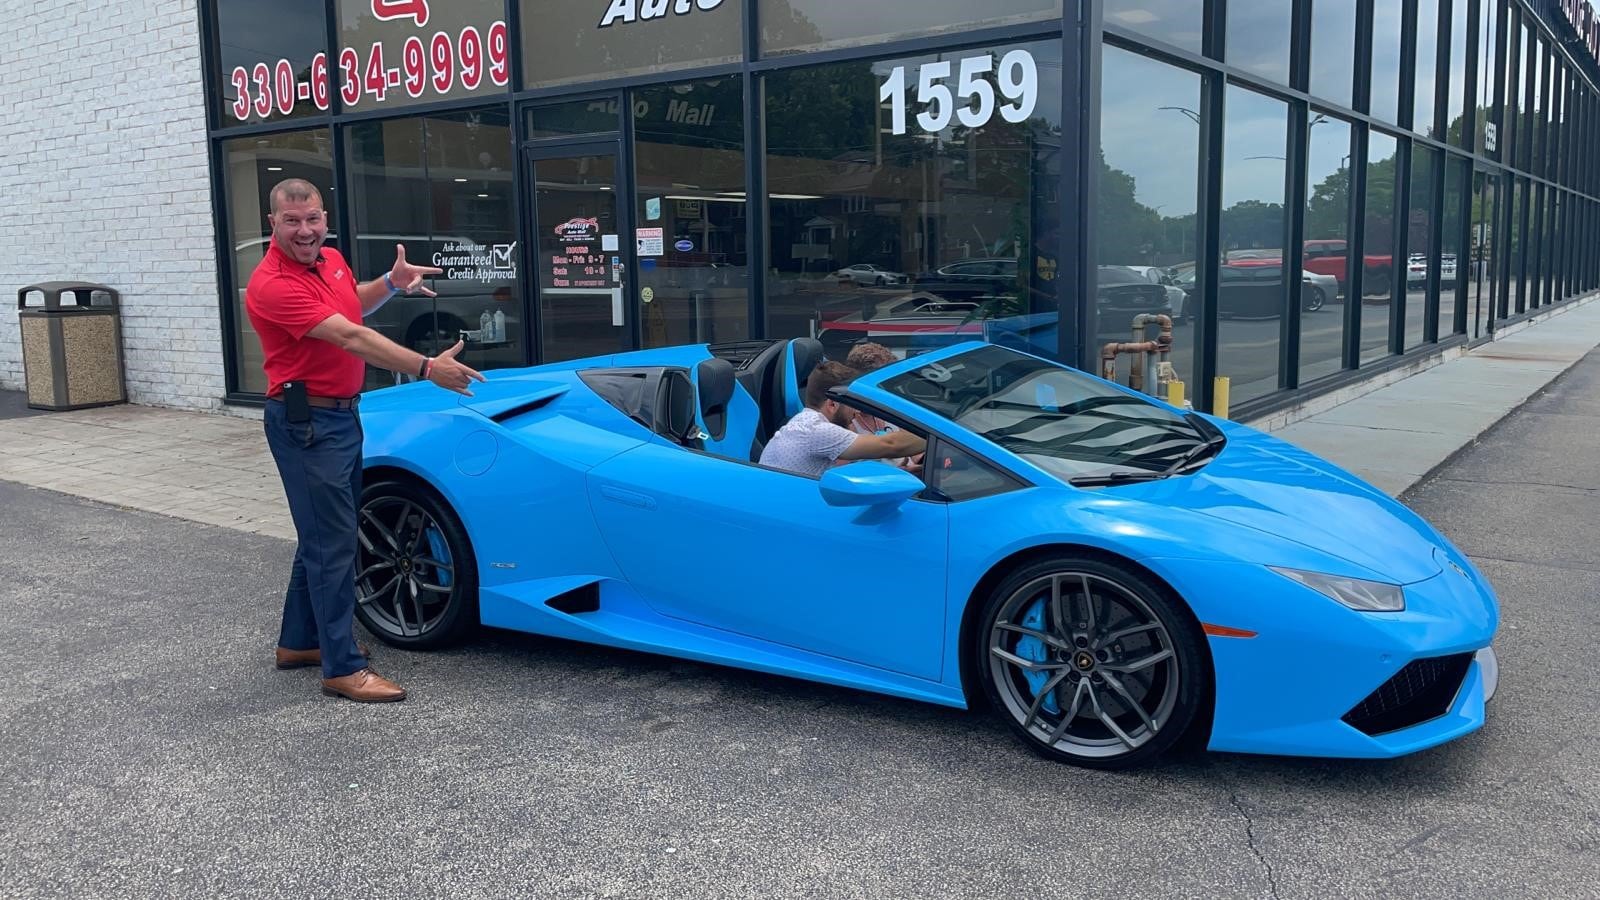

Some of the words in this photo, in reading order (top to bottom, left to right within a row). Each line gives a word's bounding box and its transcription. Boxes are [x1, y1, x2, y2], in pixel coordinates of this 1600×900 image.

[879, 49, 1038, 136] 1559
[665, 99, 715, 126] Mall
[442, 243, 455, 252] Ask
[455, 242, 474, 252] about
[432, 250, 493, 267] Guaranteed
[447, 268, 475, 280] Credit
[475, 267, 517, 283] Approval
